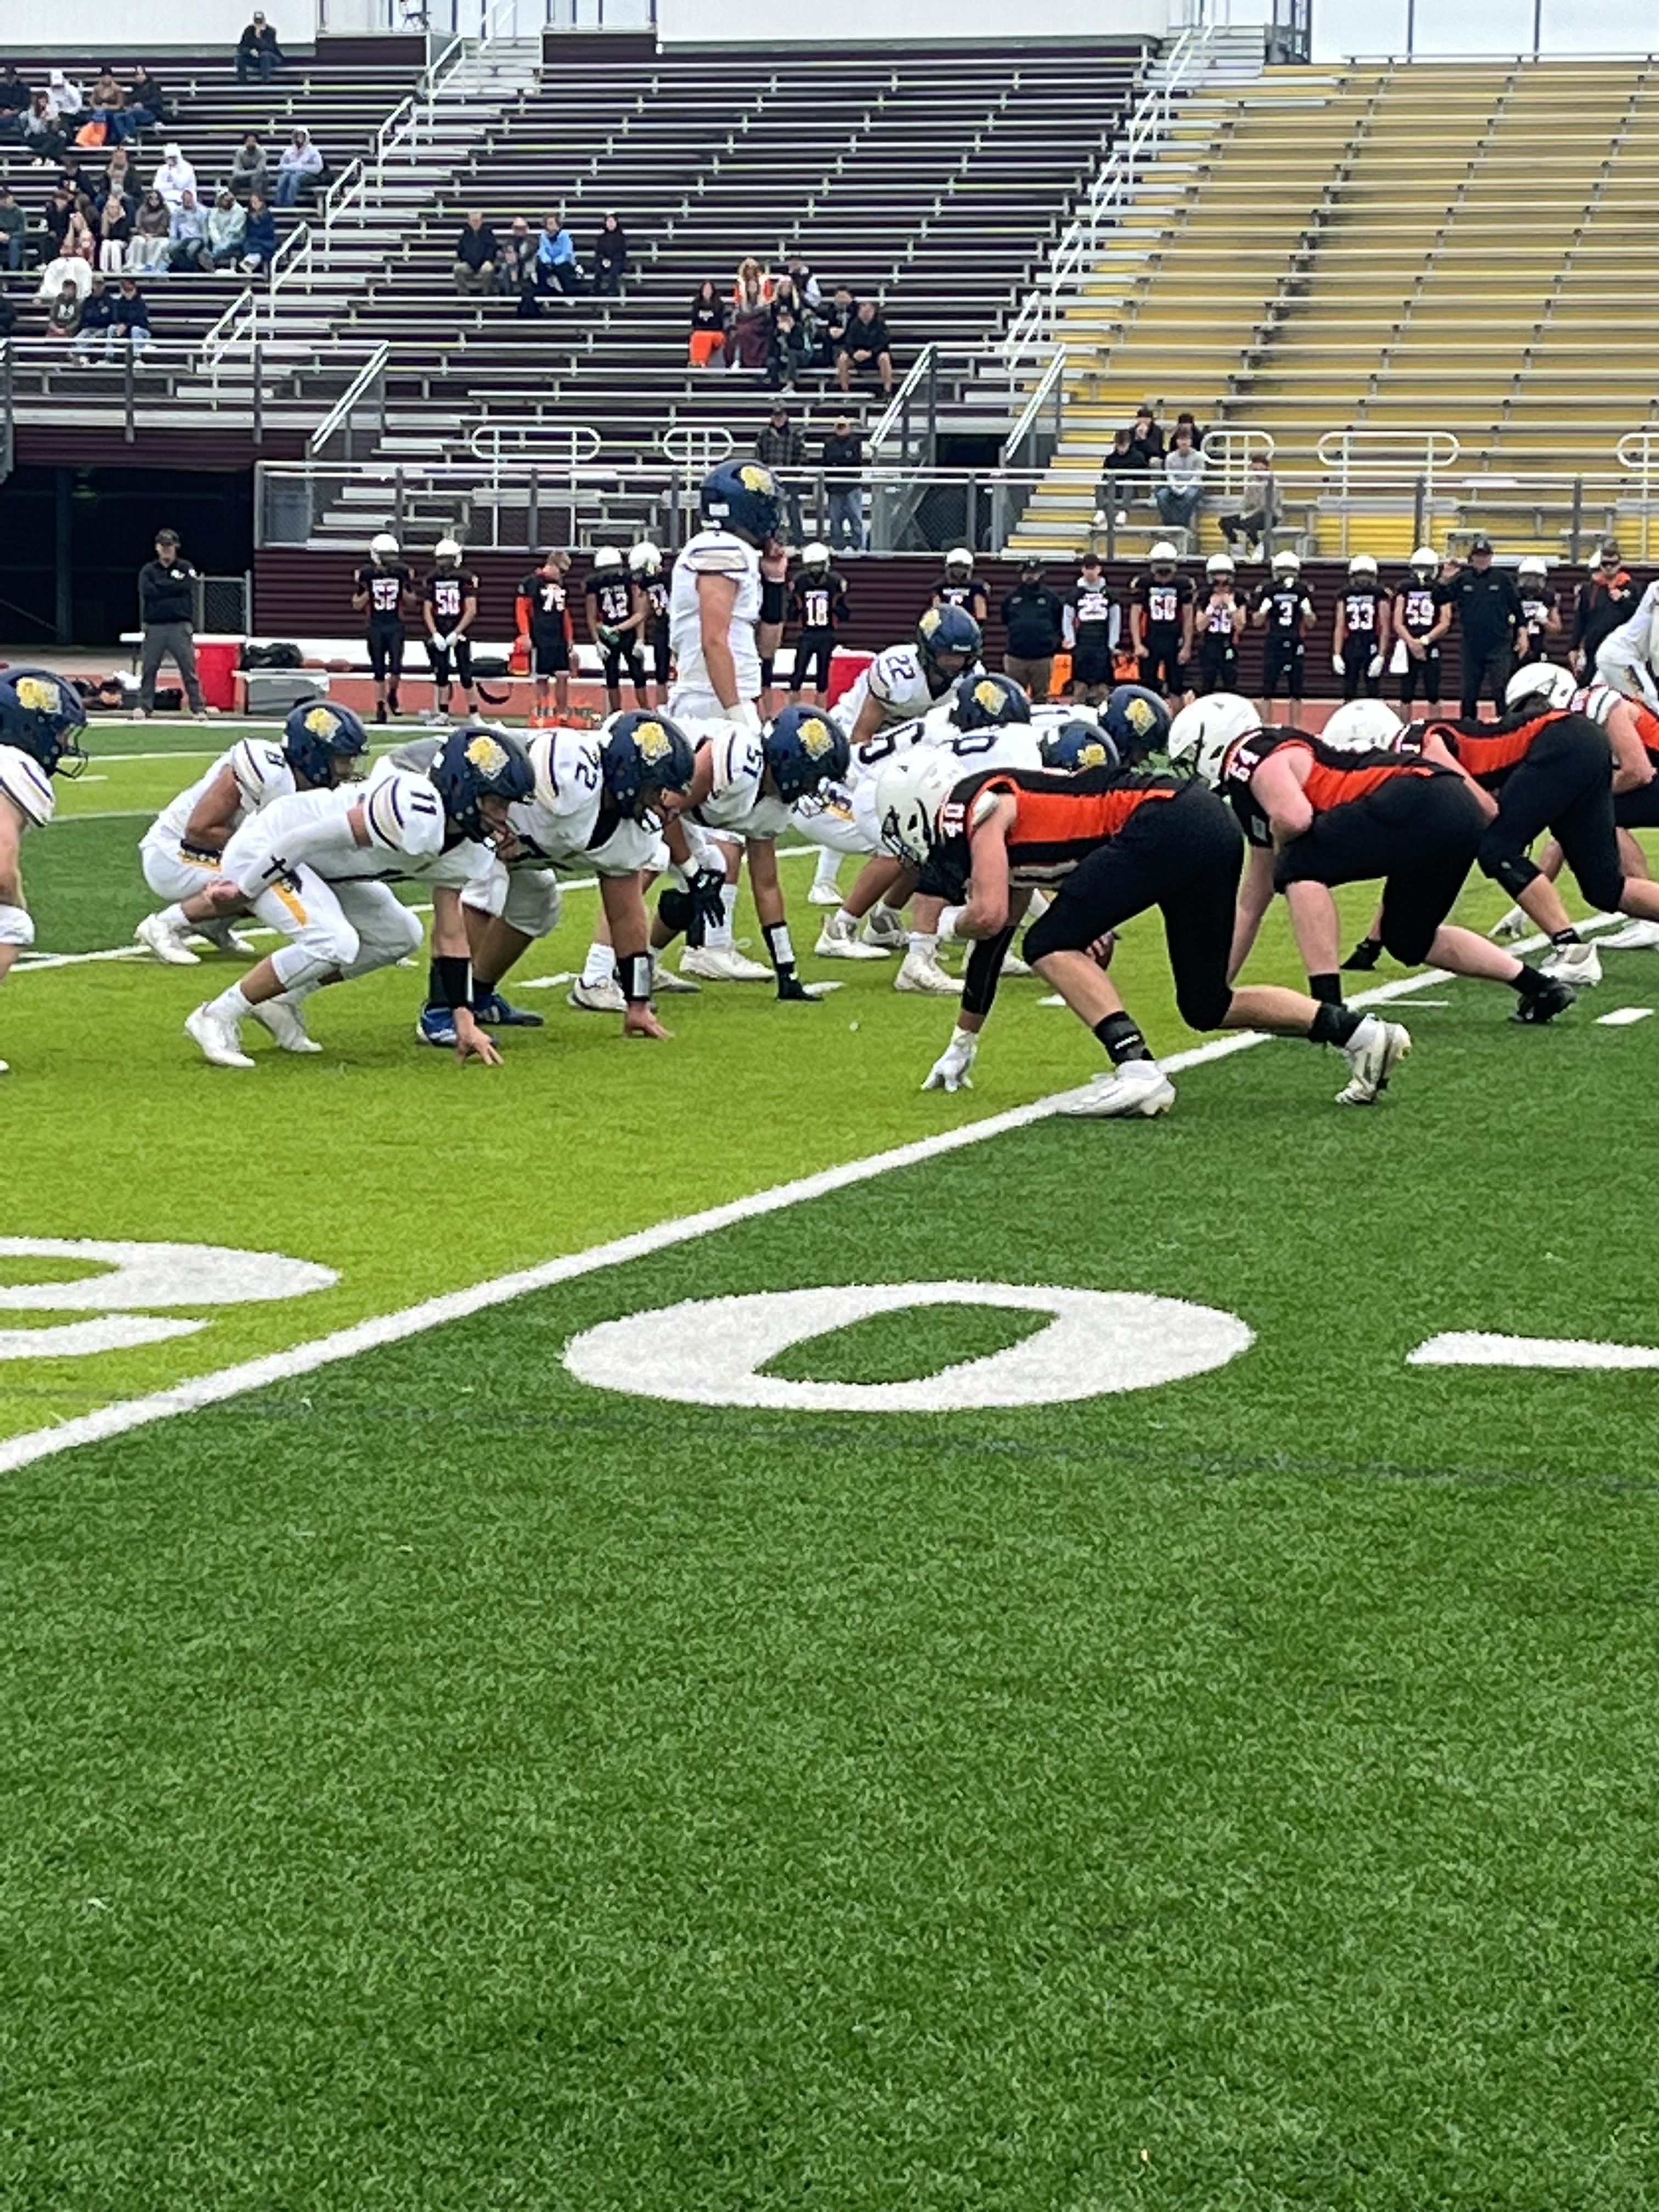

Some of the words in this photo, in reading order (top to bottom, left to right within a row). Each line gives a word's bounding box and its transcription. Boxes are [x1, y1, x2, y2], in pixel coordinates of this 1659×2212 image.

[1346, 603, 1375, 630] 33
[885, 653, 916, 682] 22
[408, 790, 437, 816] 11
[942, 802, 966, 838] 40
